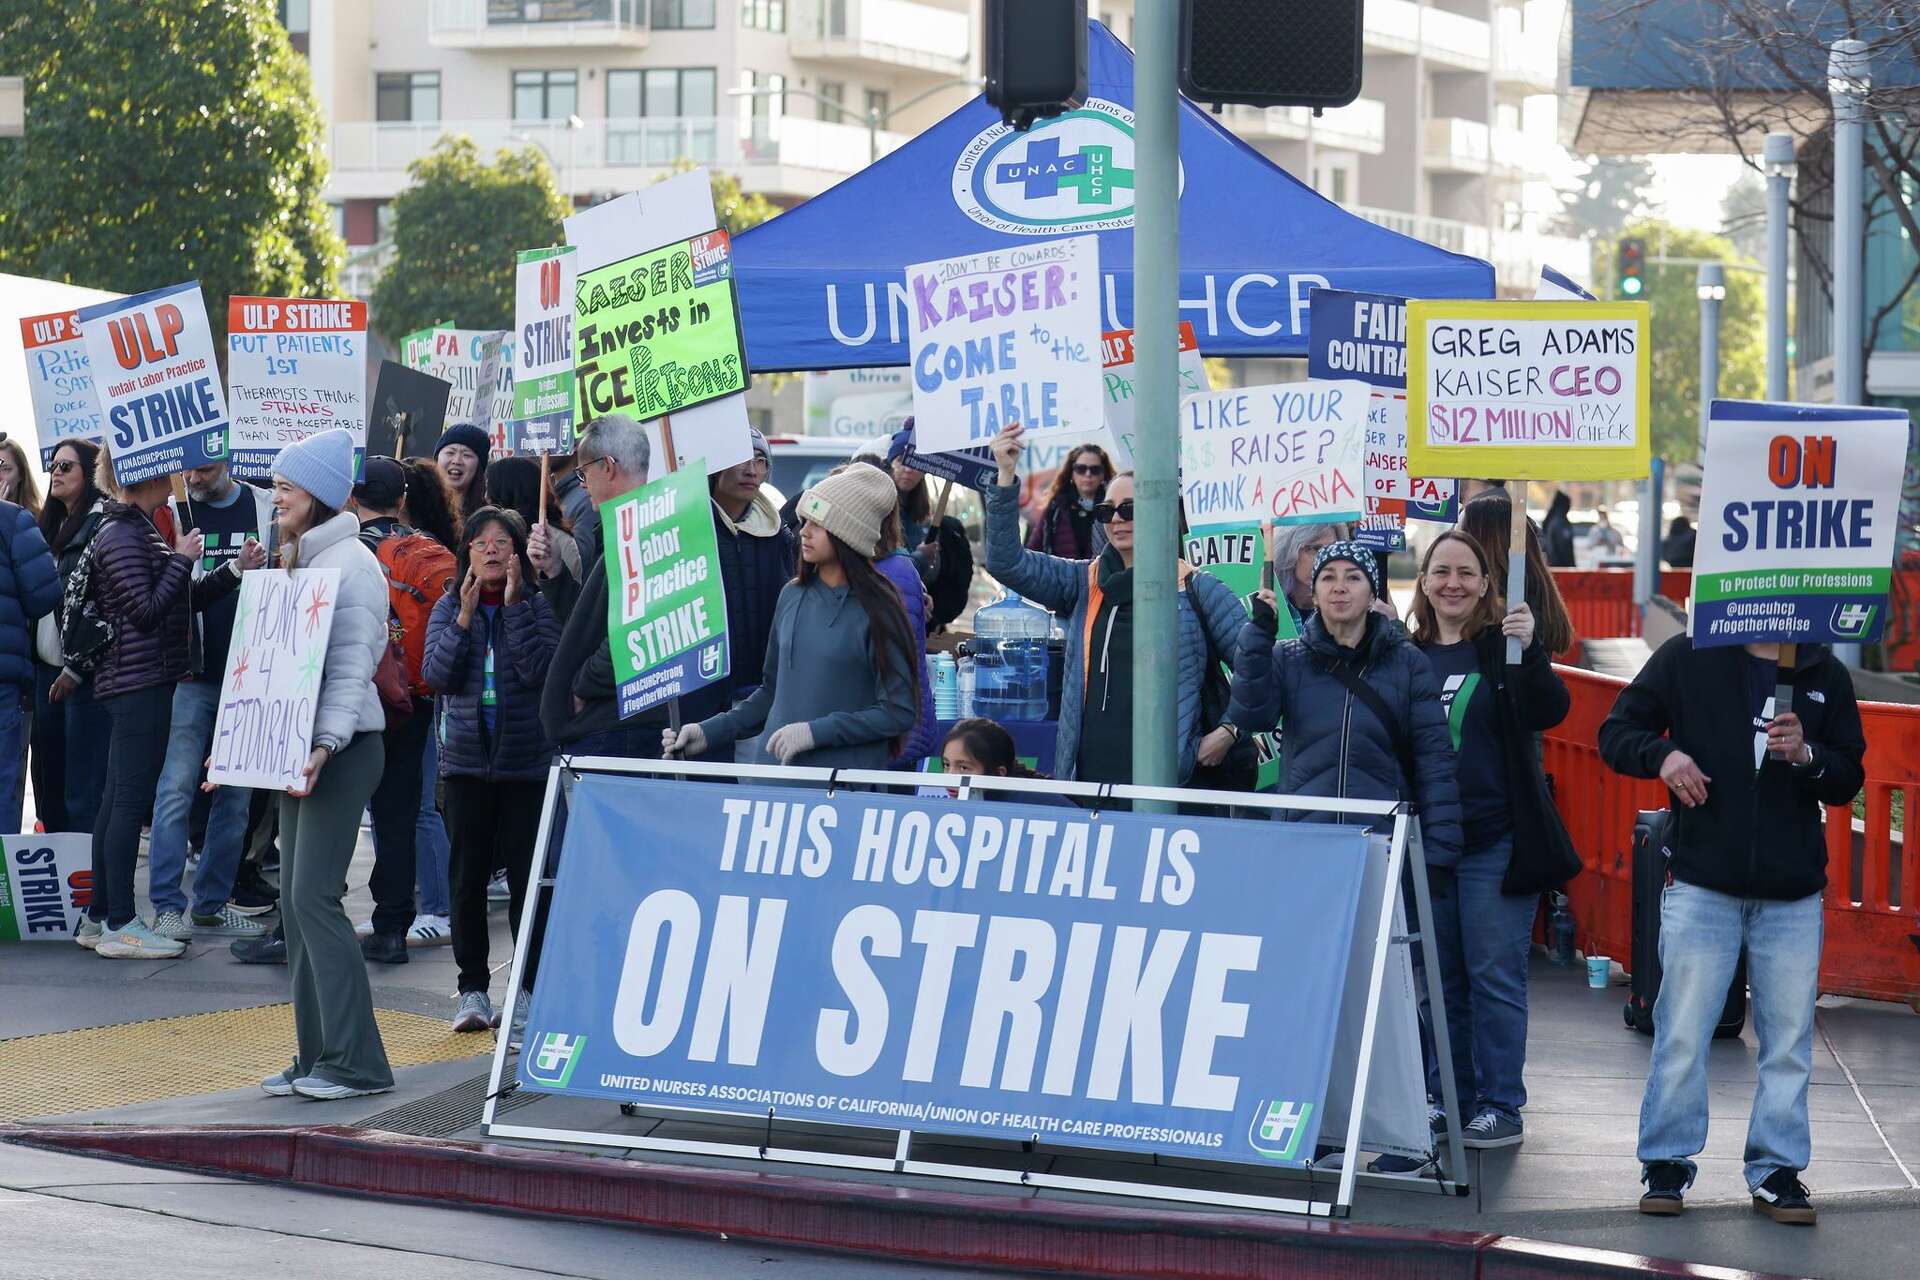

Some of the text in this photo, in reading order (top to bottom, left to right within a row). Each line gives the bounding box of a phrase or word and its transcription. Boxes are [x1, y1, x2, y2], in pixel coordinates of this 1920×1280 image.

[1087, 100, 1120, 115] tions
[958, 126, 1009, 172] United Nur
[1009, 159, 1076, 178] UNAC
[1091, 153, 1104, 197] UHCP
[967, 207, 995, 227] Union
[996, 223, 1010, 231] of
[1012, 224, 1056, 234] Health
[1061, 222, 1094, 233] Care
[691, 235, 710, 257] ULP
[693, 243, 728, 271] STRIKE
[946, 245, 1066, 278] DON'T BE COWARDS
[540, 259, 561, 311] ON
[576, 251, 692, 316] KAISER
[912, 265, 1078, 333] KAISER:
[33, 318, 65, 344] ULP
[243, 303, 353, 329] ULP STRIKE
[579, 297, 711, 362] Invests in
[107, 303, 184, 370] ULP
[230, 334, 353, 356] PUT PATIENTS
[436, 334, 459, 356] PA
[524, 314, 571, 369] STRIKE
[1432, 325, 1635, 358] GREG ADAMS
[266, 356, 298, 375] 1ST
[915, 323, 1090, 393] COME to the
[108, 358, 206, 397] Unfair Labor Practice
[850, 370, 901, 384] thrive
[1435, 365, 1622, 397] KAISER CEO
[232, 385, 360, 404] THERAPISTS THINK
[261, 401, 334, 417] STRIKES
[576, 361, 635, 432] ICE
[1191, 389, 1343, 430] LIKE YOUR
[46, 414, 100, 437] PROF
[110, 377, 220, 449] STRIKE
[236, 416, 363, 430] ARE MORE ACCEPTABLE
[1431, 403, 1573, 443] $12 MILLION
[1580, 402, 1622, 422] PAY
[240, 431, 269, 441] THAN
[1577, 423, 1633, 442] CHECK
[117, 446, 185, 471] #UNACUHCPstrong
[120, 460, 182, 484] #TogetherWeWin
[232, 452, 276, 464] #UNACUHC
[1366, 452, 1408, 471] AISER
[1768, 434, 1838, 489] ON
[1186, 468, 1355, 517] THANK A CRNA
[1375, 479, 1396, 493] OF
[1722, 499, 1874, 552] STRIKE
[1186, 534, 1255, 568] CATE
[1719, 573, 1873, 593] To Protect Our Professions
[252, 576, 308, 656] HONK
[1727, 601, 1796, 617] @unacuhcp
[627, 596, 710, 671] STRIKE
[1710, 618, 1810, 634] #TogetherWeRise
[259, 647, 275, 695] 4
[1440, 693, 1454, 701] CP
[215, 697, 309, 780] EPIDURALS
[719, 798, 1201, 906] THIS HOSPITAL IS
[15, 847, 68, 933] STRIKE
[612, 889, 1262, 1111] ON STRIKE
[600, 1074, 1224, 1148] UNITED NURSES ASSOCIATIONS OF CALIFORNIA/UNION OF HEALTH CARE PROFESSIONALS
